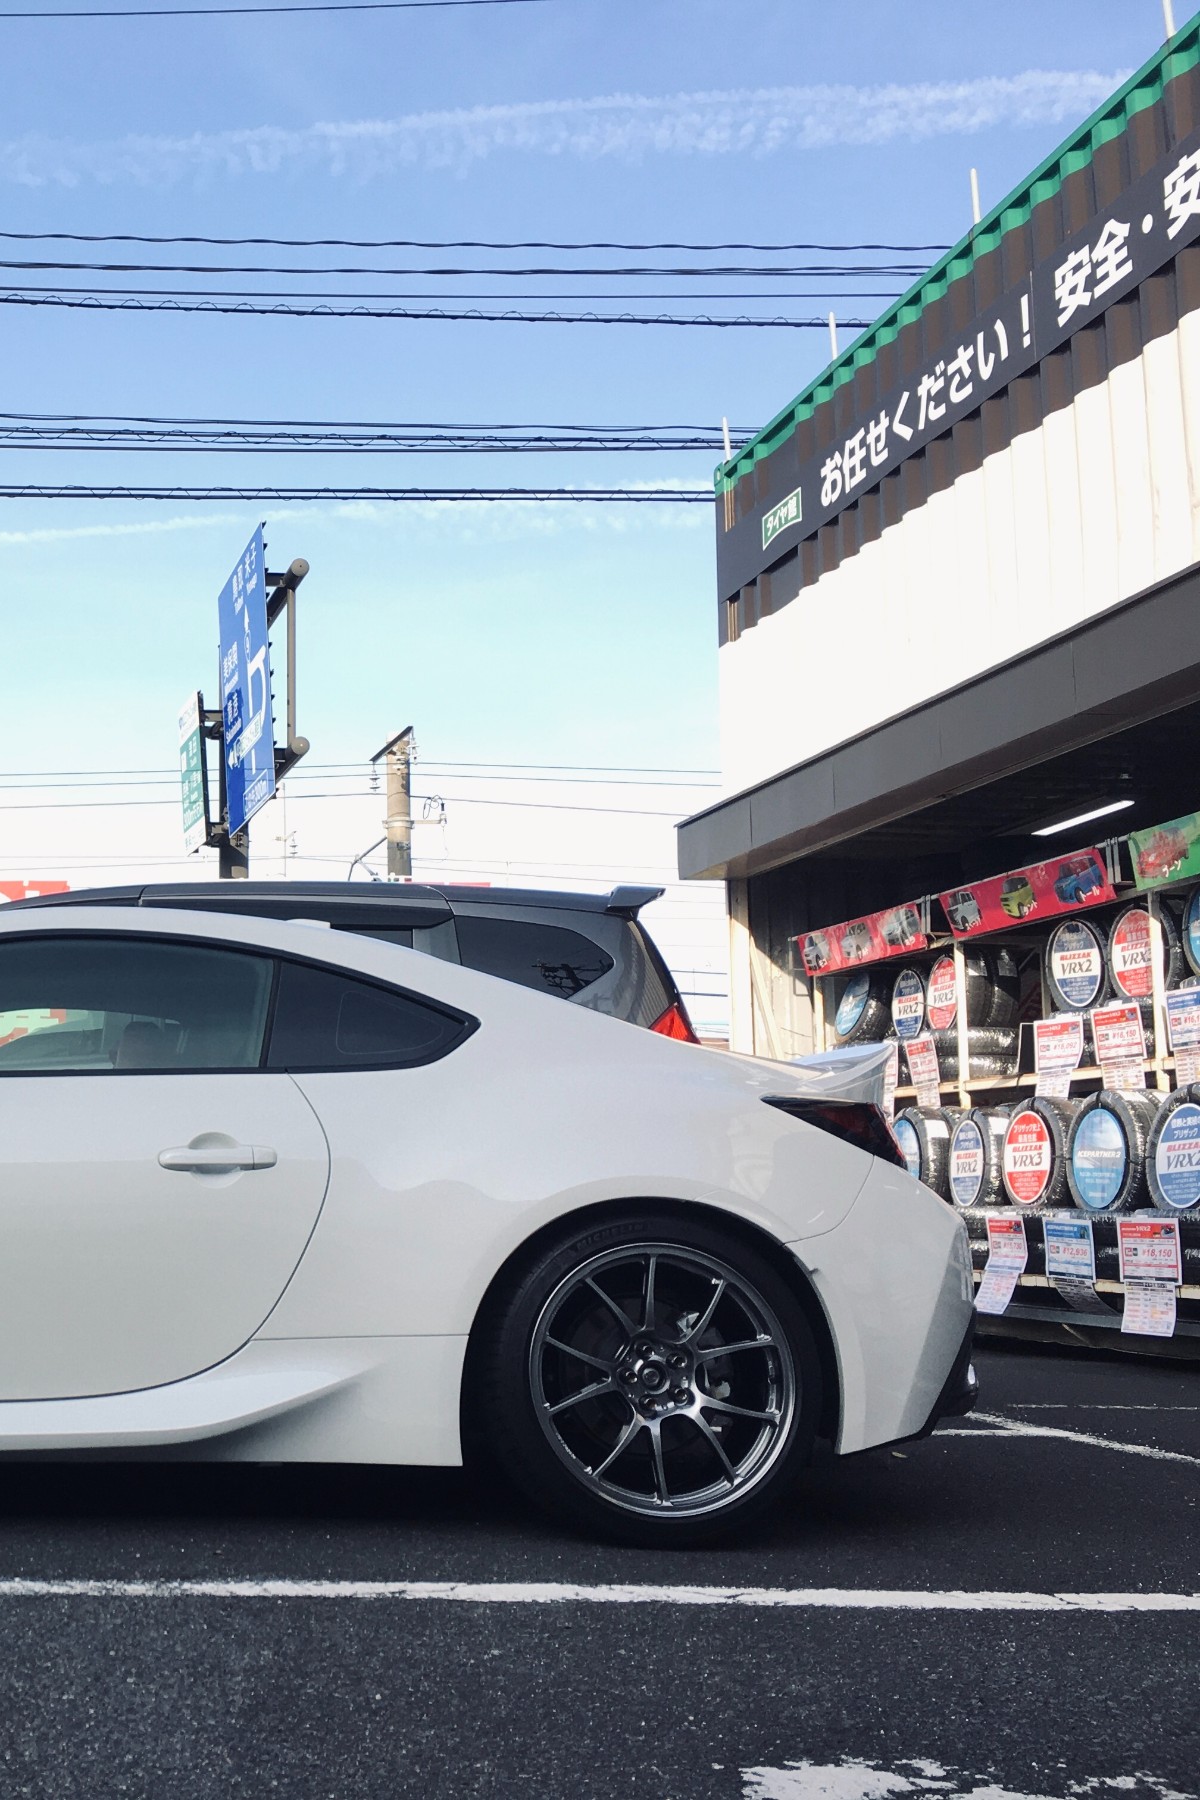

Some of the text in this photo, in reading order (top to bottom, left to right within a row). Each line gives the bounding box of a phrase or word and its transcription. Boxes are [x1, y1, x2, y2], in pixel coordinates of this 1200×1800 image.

[766, 496, 798, 537] タイヤ館
[1060, 951, 1092, 961] BLIZZAK
[1061, 959, 1092, 976] VRX2
[933, 989, 954, 1005] VRX3
[897, 1002, 918, 1016] VRX2
[1012, 1144, 1043, 1153] BLIZZAK
[956, 1159, 978, 1175] VRX2
[1013, 1152, 1043, 1169] VRX3
[1142, 1247, 1172, 1258] ¥18,150
